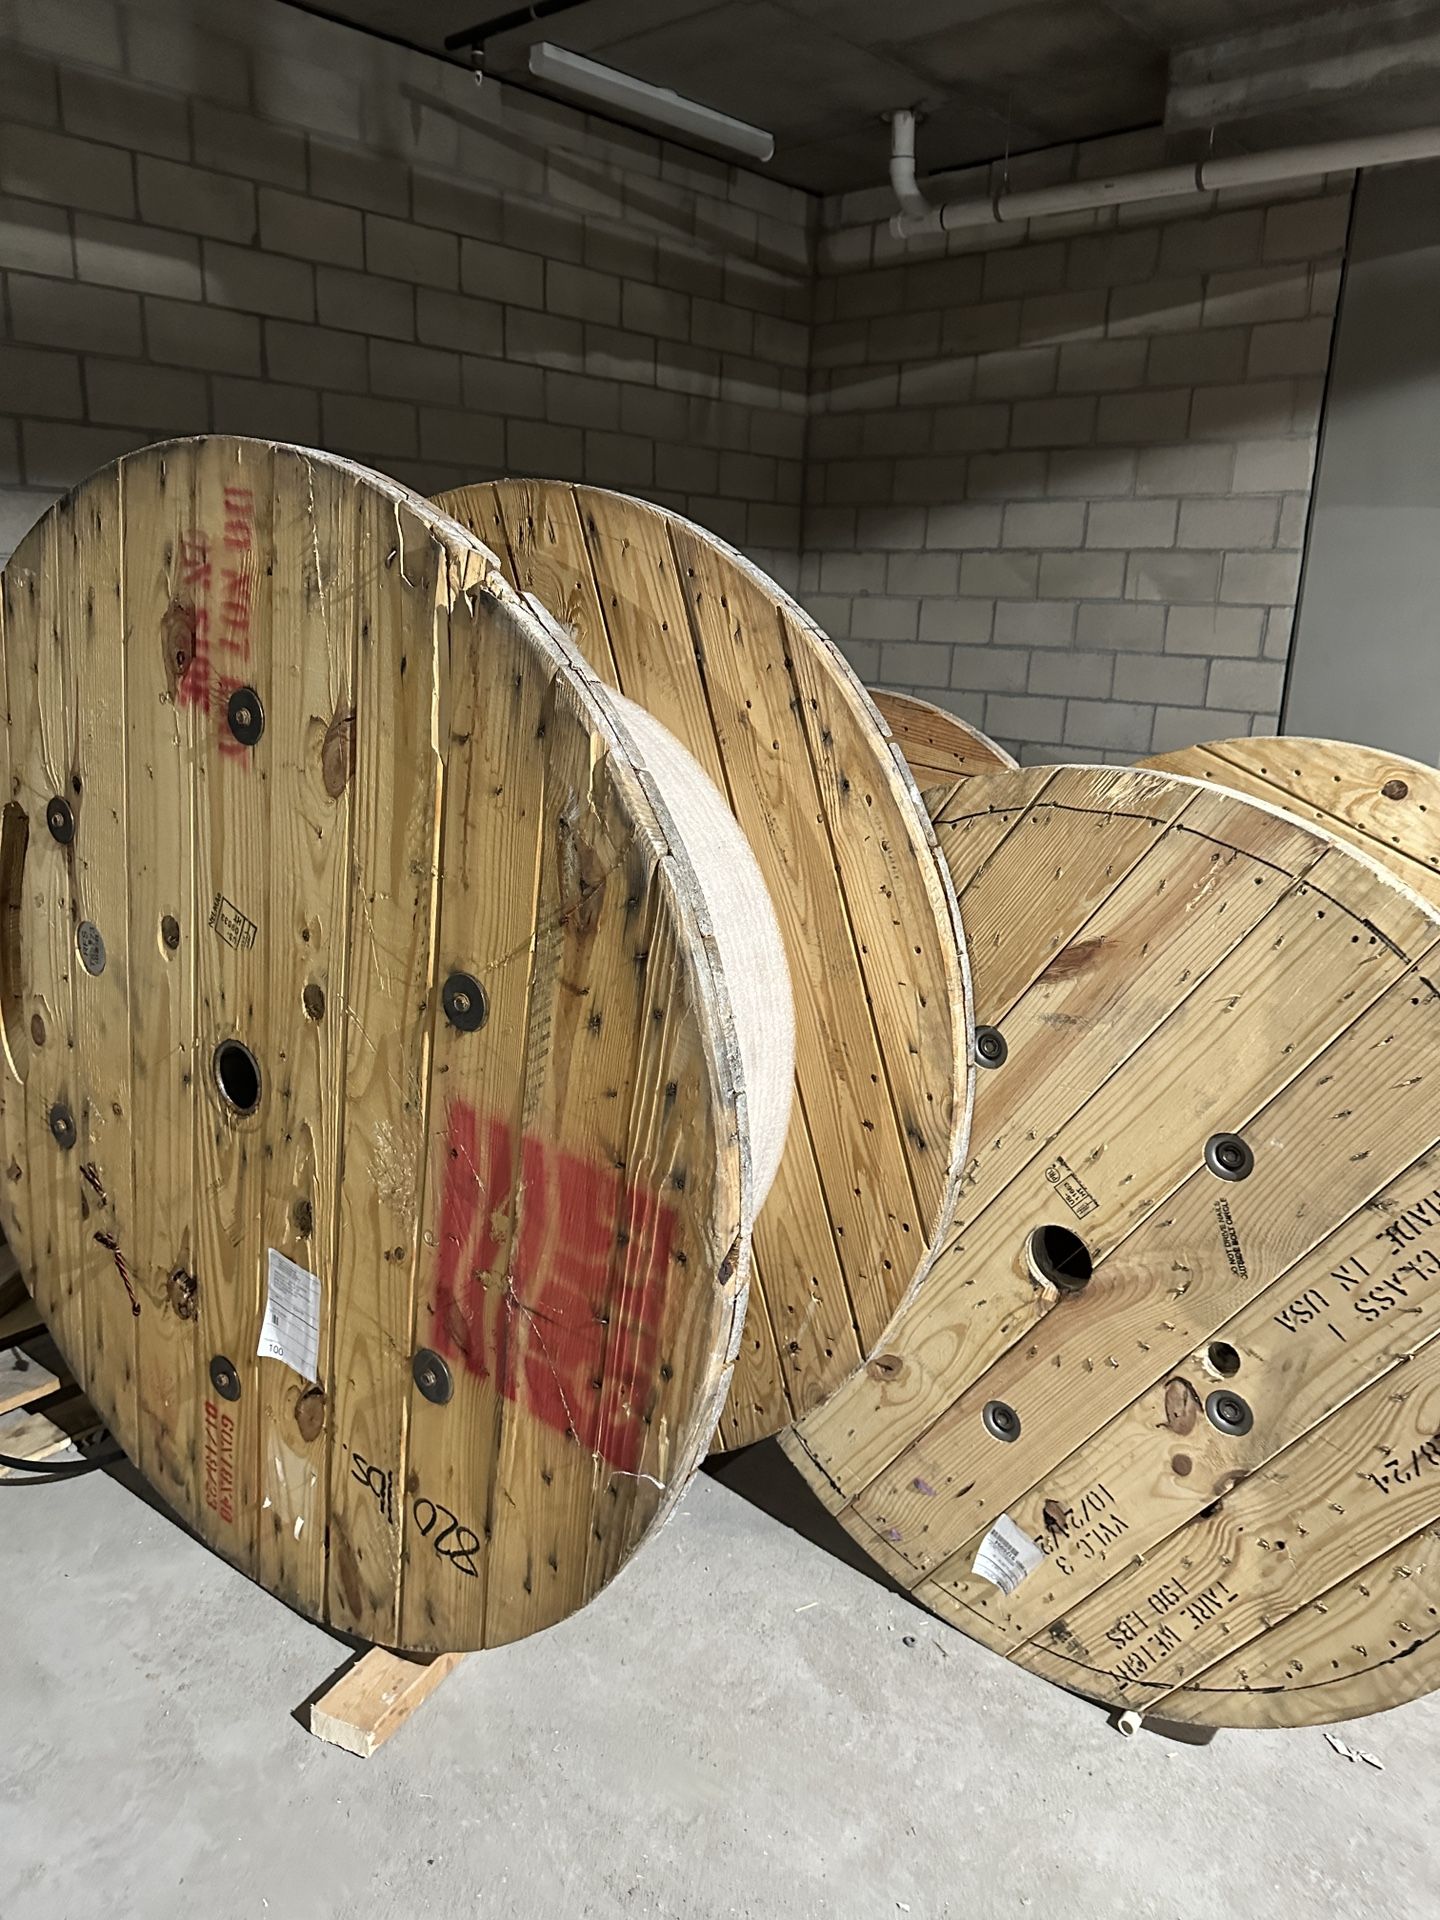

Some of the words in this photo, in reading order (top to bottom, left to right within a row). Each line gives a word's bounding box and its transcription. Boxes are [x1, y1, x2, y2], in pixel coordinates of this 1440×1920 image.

[1331, 1256, 1370, 1292] IN
[1274, 1289, 1330, 1332] USA
[268, 1343, 284, 1357] 100
[1147, 1576, 1189, 1615] 190
[1179, 1580, 1239, 1631] TARE
[1105, 1609, 1149, 1650] LBS
[1109, 1623, 1182, 1691] WEIGHT
